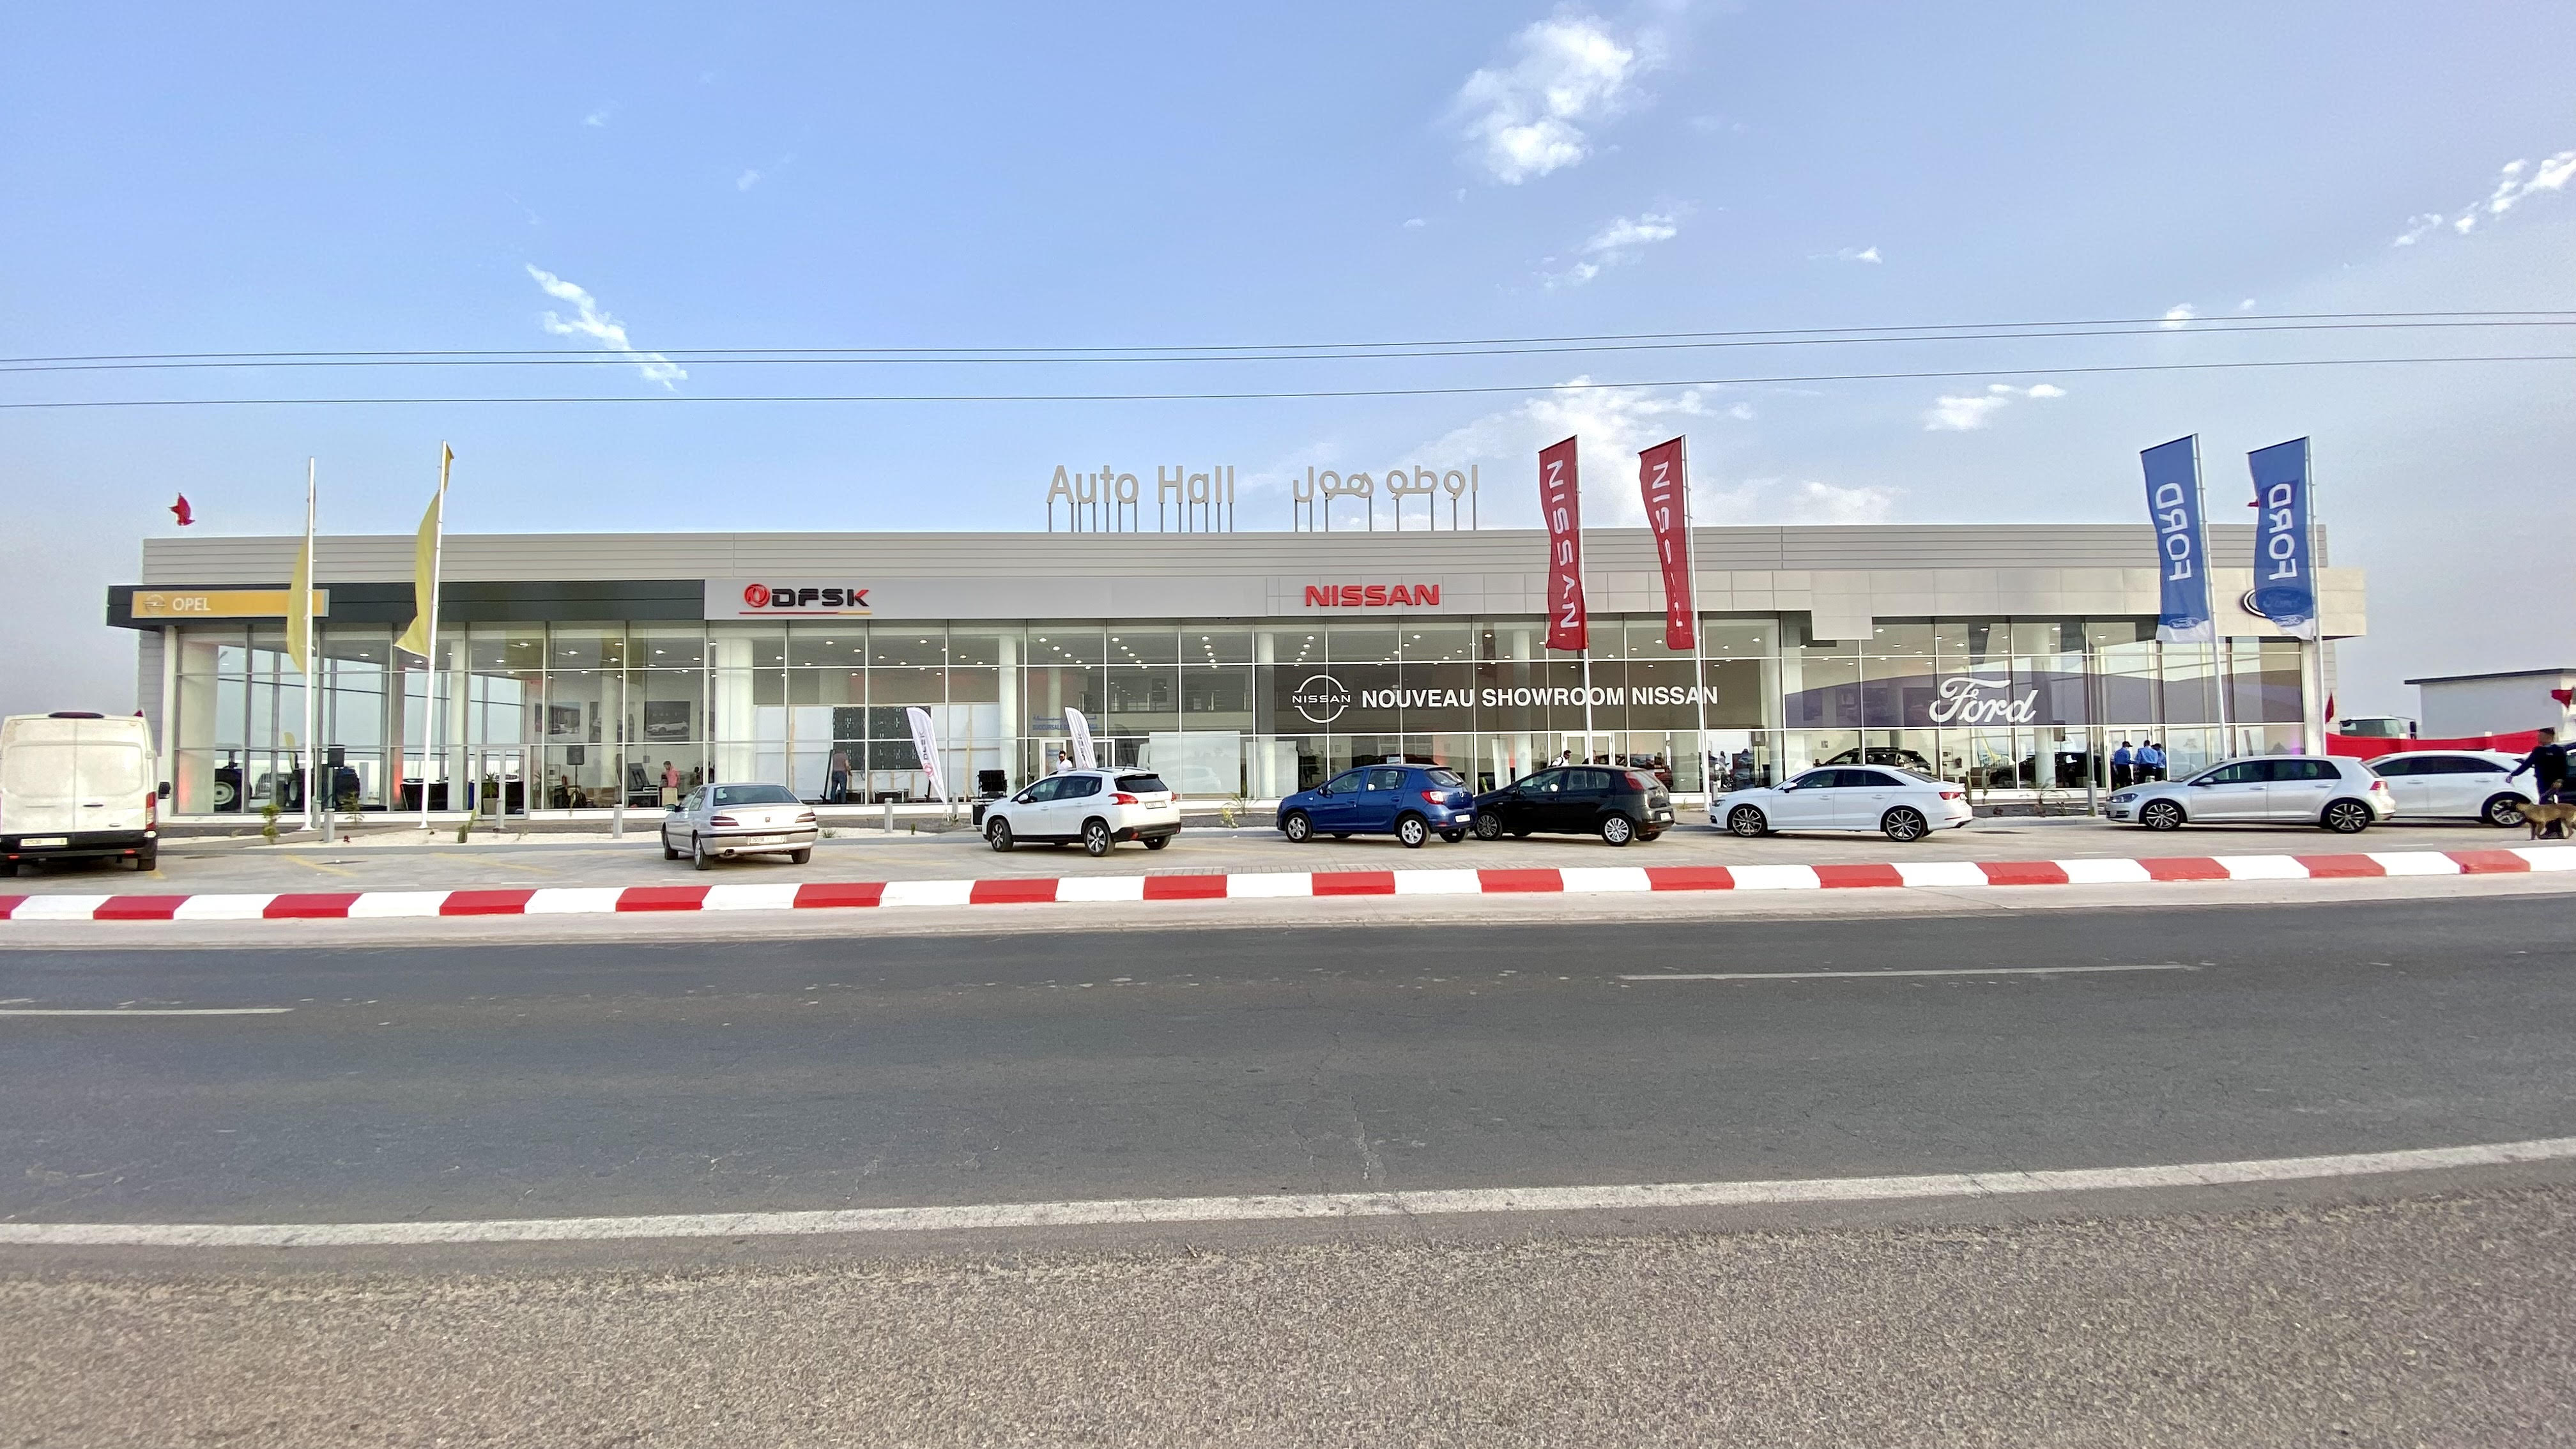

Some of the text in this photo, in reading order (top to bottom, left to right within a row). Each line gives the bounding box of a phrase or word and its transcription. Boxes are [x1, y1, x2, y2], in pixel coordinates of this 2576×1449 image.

[1046, 465, 1234, 504] Auto Hall
[1293, 464, 1478, 503] اوطو هول
[1547, 459, 1579, 628] NISSAN
[172, 597, 211, 611] OPEL
[772, 588, 870, 607] DFSK
[1306, 585, 1439, 606] NISSAN
[1292, 694, 1351, 703] NISSAN
[1362, 686, 1717, 708] NOUVEAU SHOWROOM NISSAN
[1929, 677, 2039, 723] Ford
